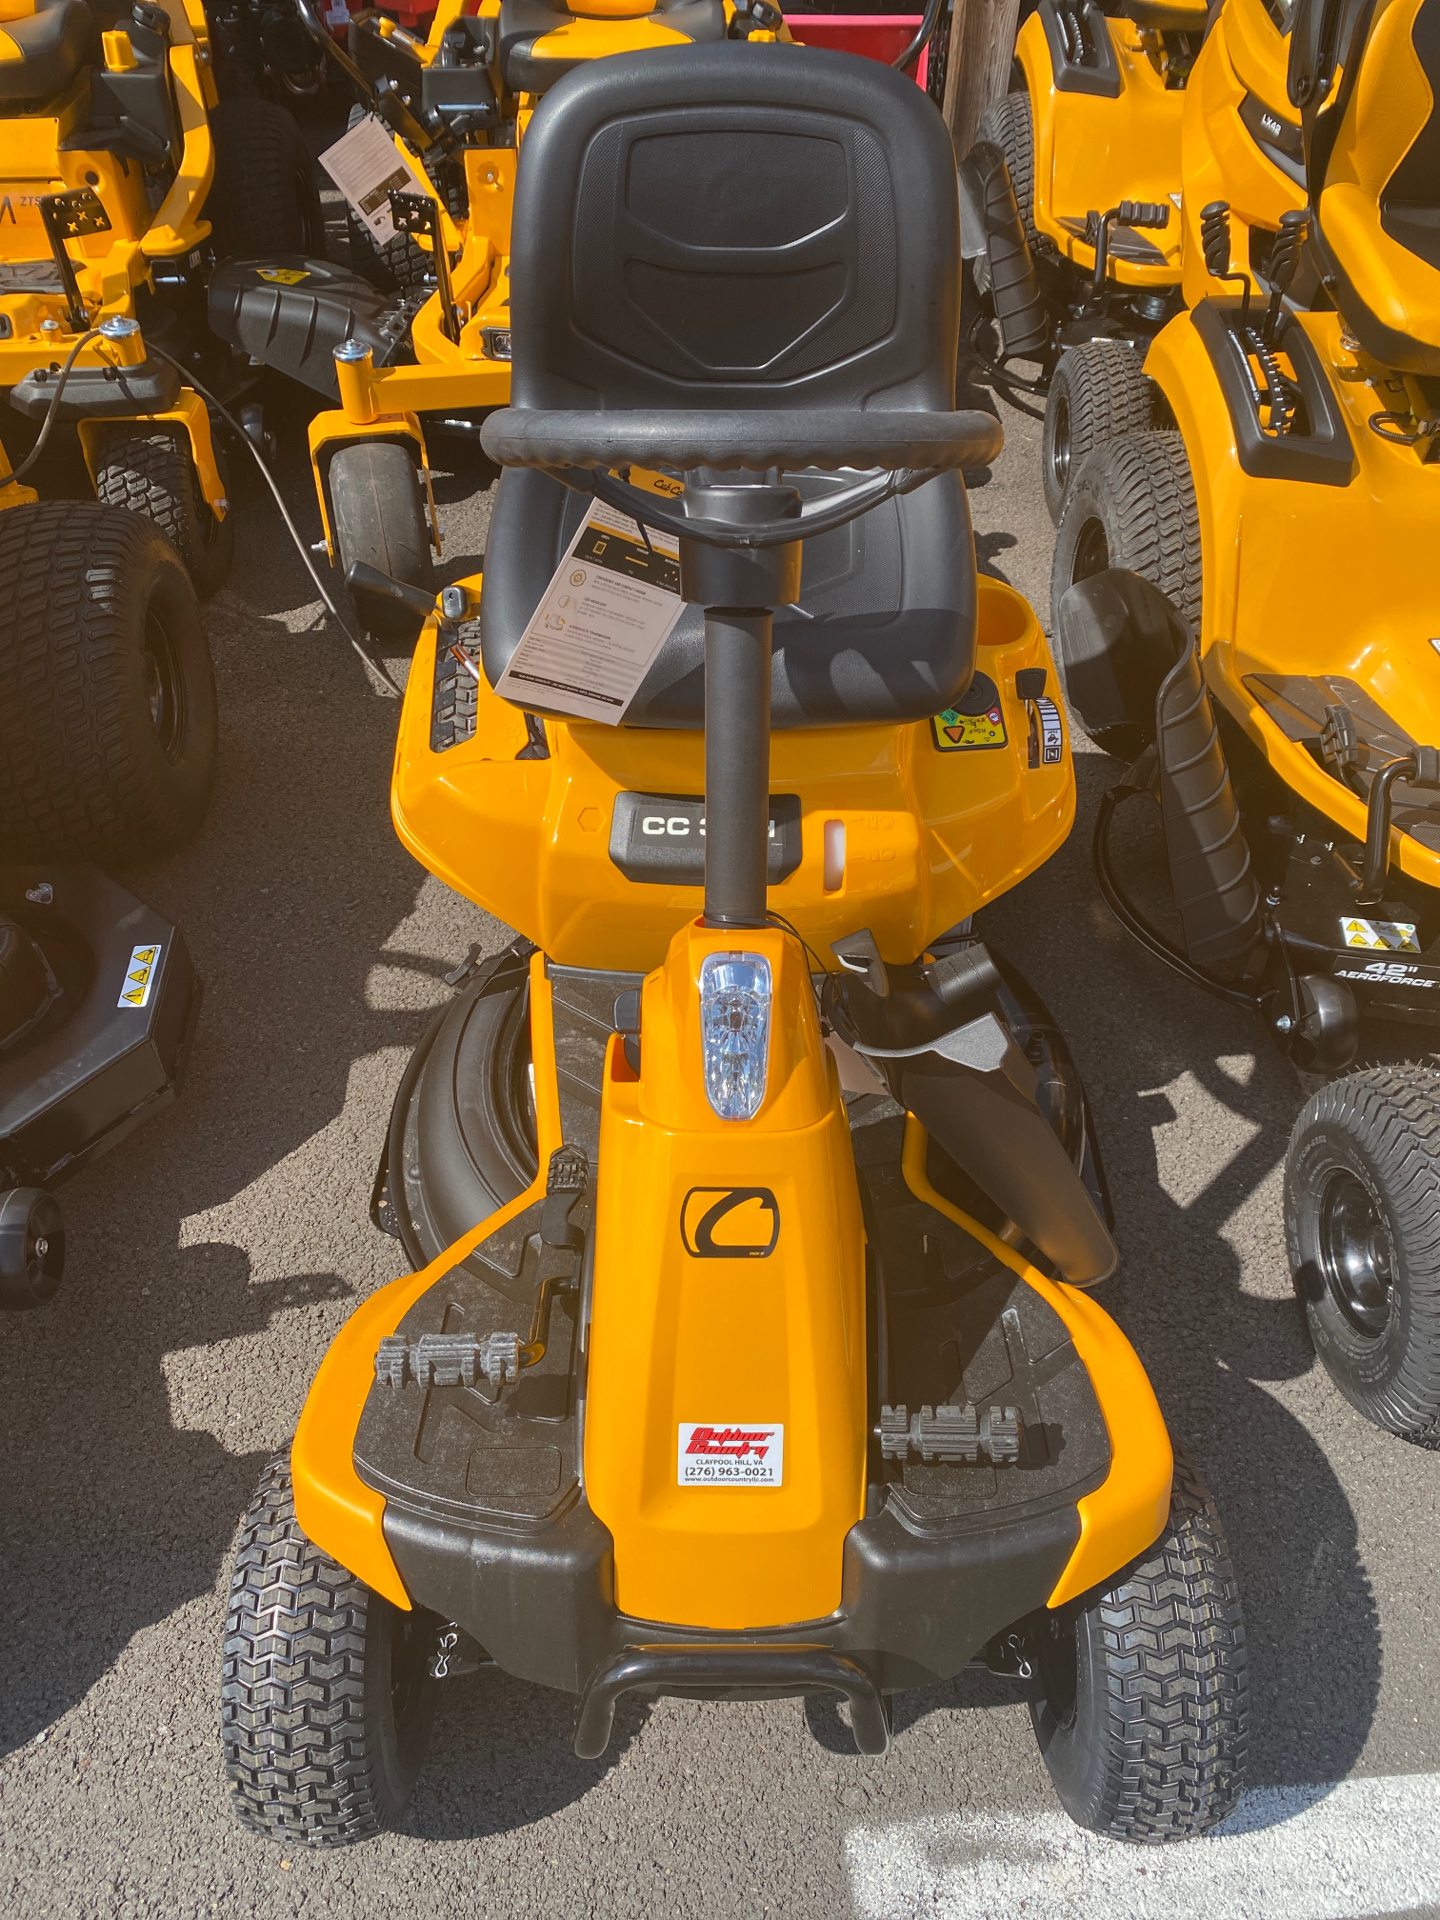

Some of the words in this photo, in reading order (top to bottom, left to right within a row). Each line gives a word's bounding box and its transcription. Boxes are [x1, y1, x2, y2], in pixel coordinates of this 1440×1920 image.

[653, 479, 671, 491] Cub
[642, 816, 690, 836] CC
[1365, 962, 1418, 976] 42"
[1334, 970, 1436, 988] AEROFORCE
[690, 1427, 775, 1446] Outdoor
[685, 1440, 769, 1459] Country
[685, 1467, 715, 1477] (276)
[718, 1467, 773, 1476] 963-0021
